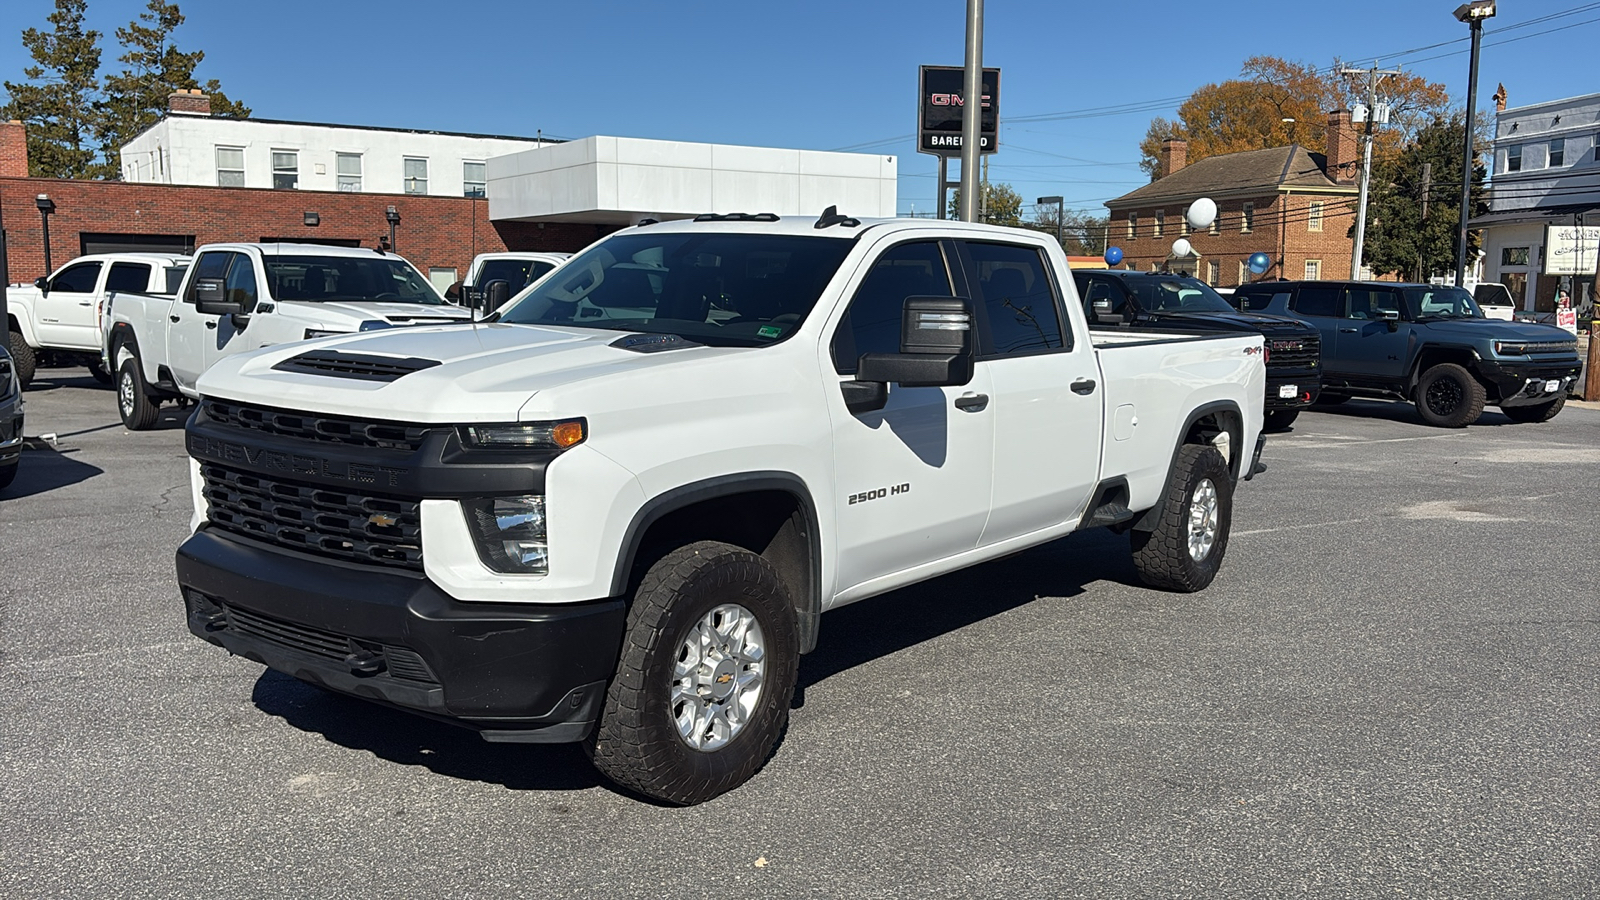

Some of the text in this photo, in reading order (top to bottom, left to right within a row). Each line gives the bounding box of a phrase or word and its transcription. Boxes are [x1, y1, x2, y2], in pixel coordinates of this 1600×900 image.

[931, 136, 988, 147] BARED
[189, 435, 410, 487] CHEVROLET
[848, 482, 910, 506] 2500 HD
